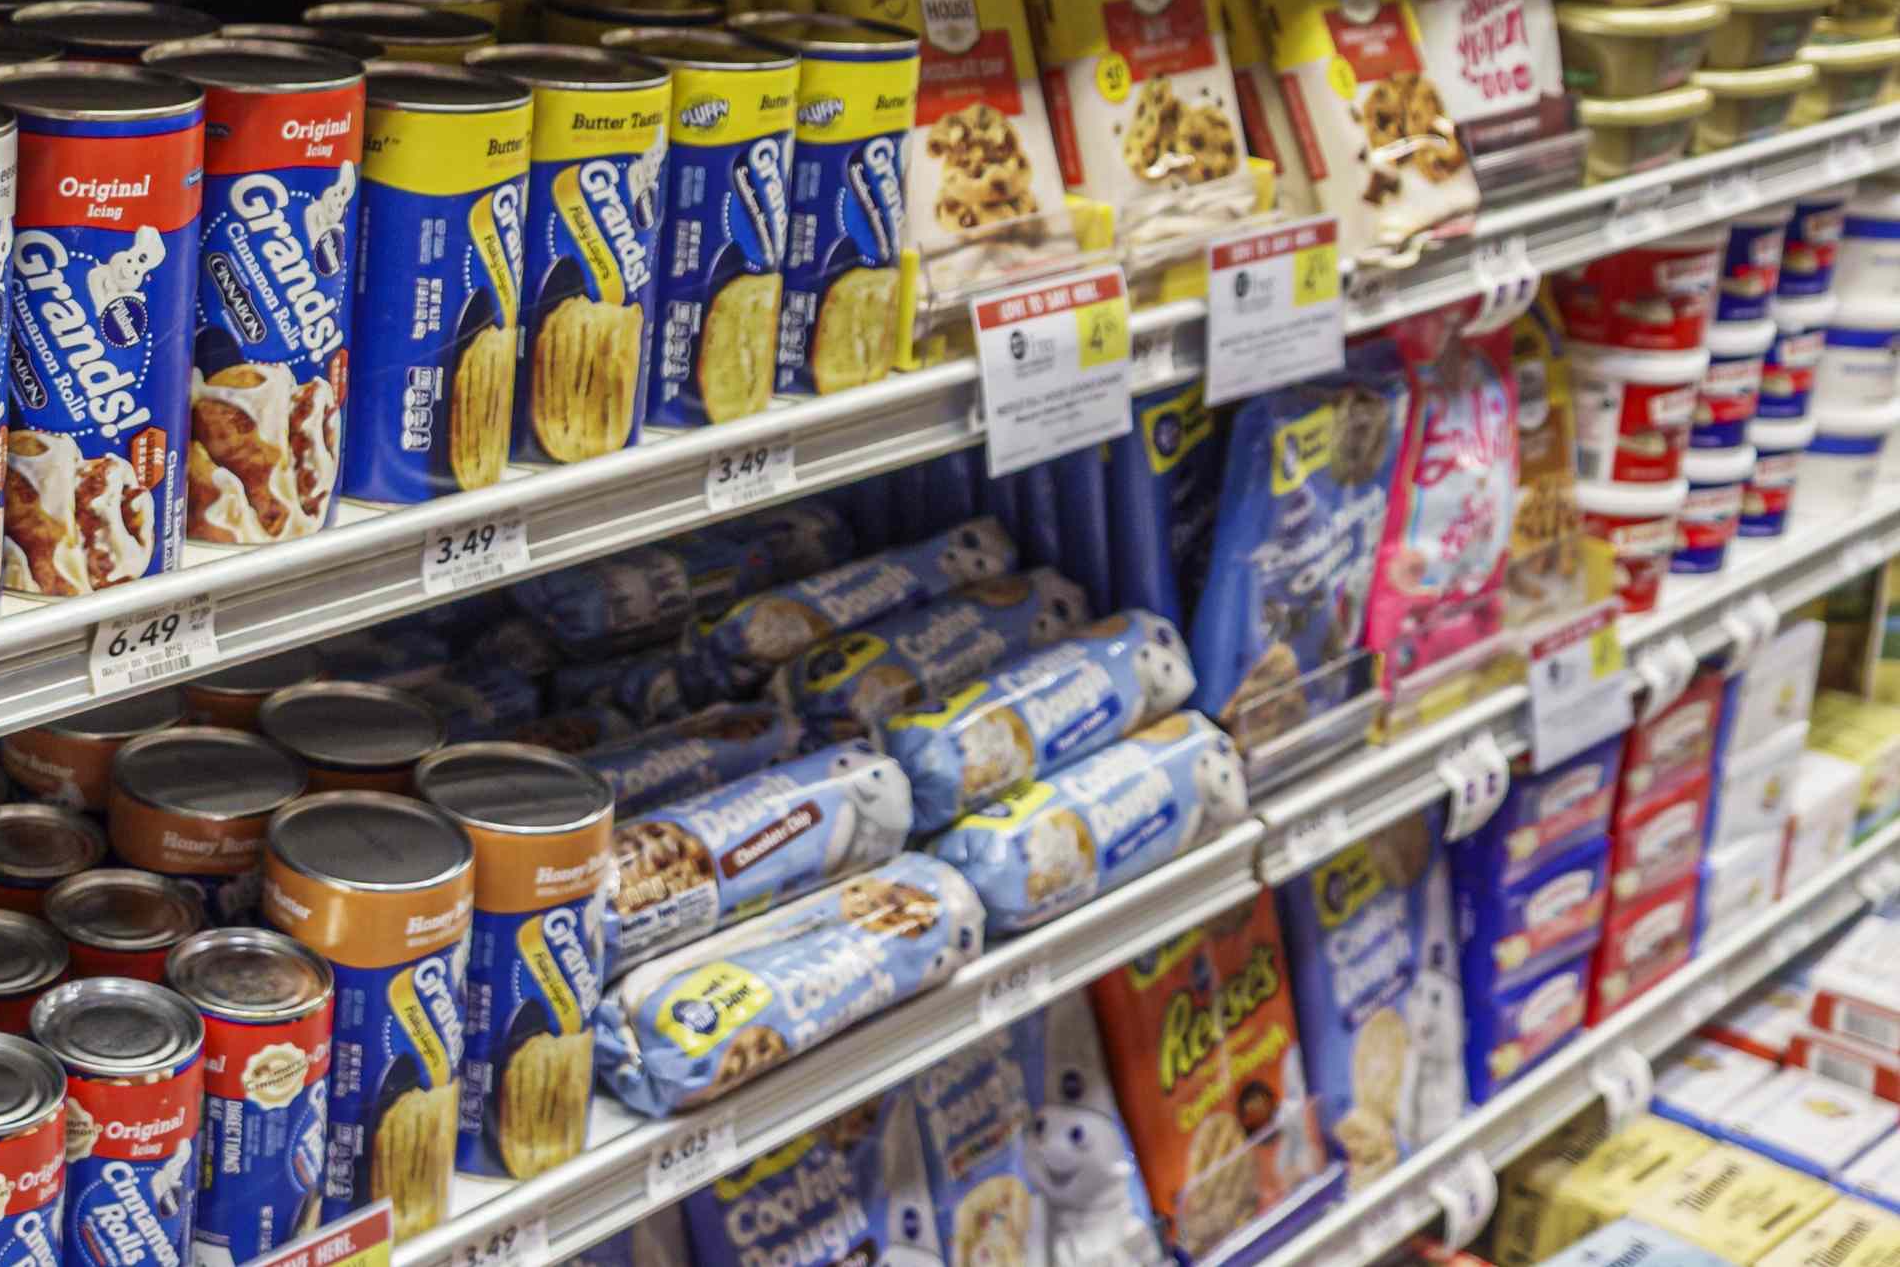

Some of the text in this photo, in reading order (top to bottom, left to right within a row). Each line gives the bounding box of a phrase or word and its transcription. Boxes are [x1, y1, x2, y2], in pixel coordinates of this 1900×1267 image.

[282, 112, 351, 141] Original
[571, 113, 628, 132] Butter
[59, 175, 151, 202] Original
[87, 205, 123, 219] Icing
[230, 174, 344, 363] Grands!
[14, 231, 151, 438] Grands!
[717, 448, 768, 484] 3.49
[436, 523, 496, 565] 3.49
[109, 614, 180, 657] 6.49
[105, 1108, 185, 1140] Original
[224, 1101, 243, 1174] DIRECTIONS
